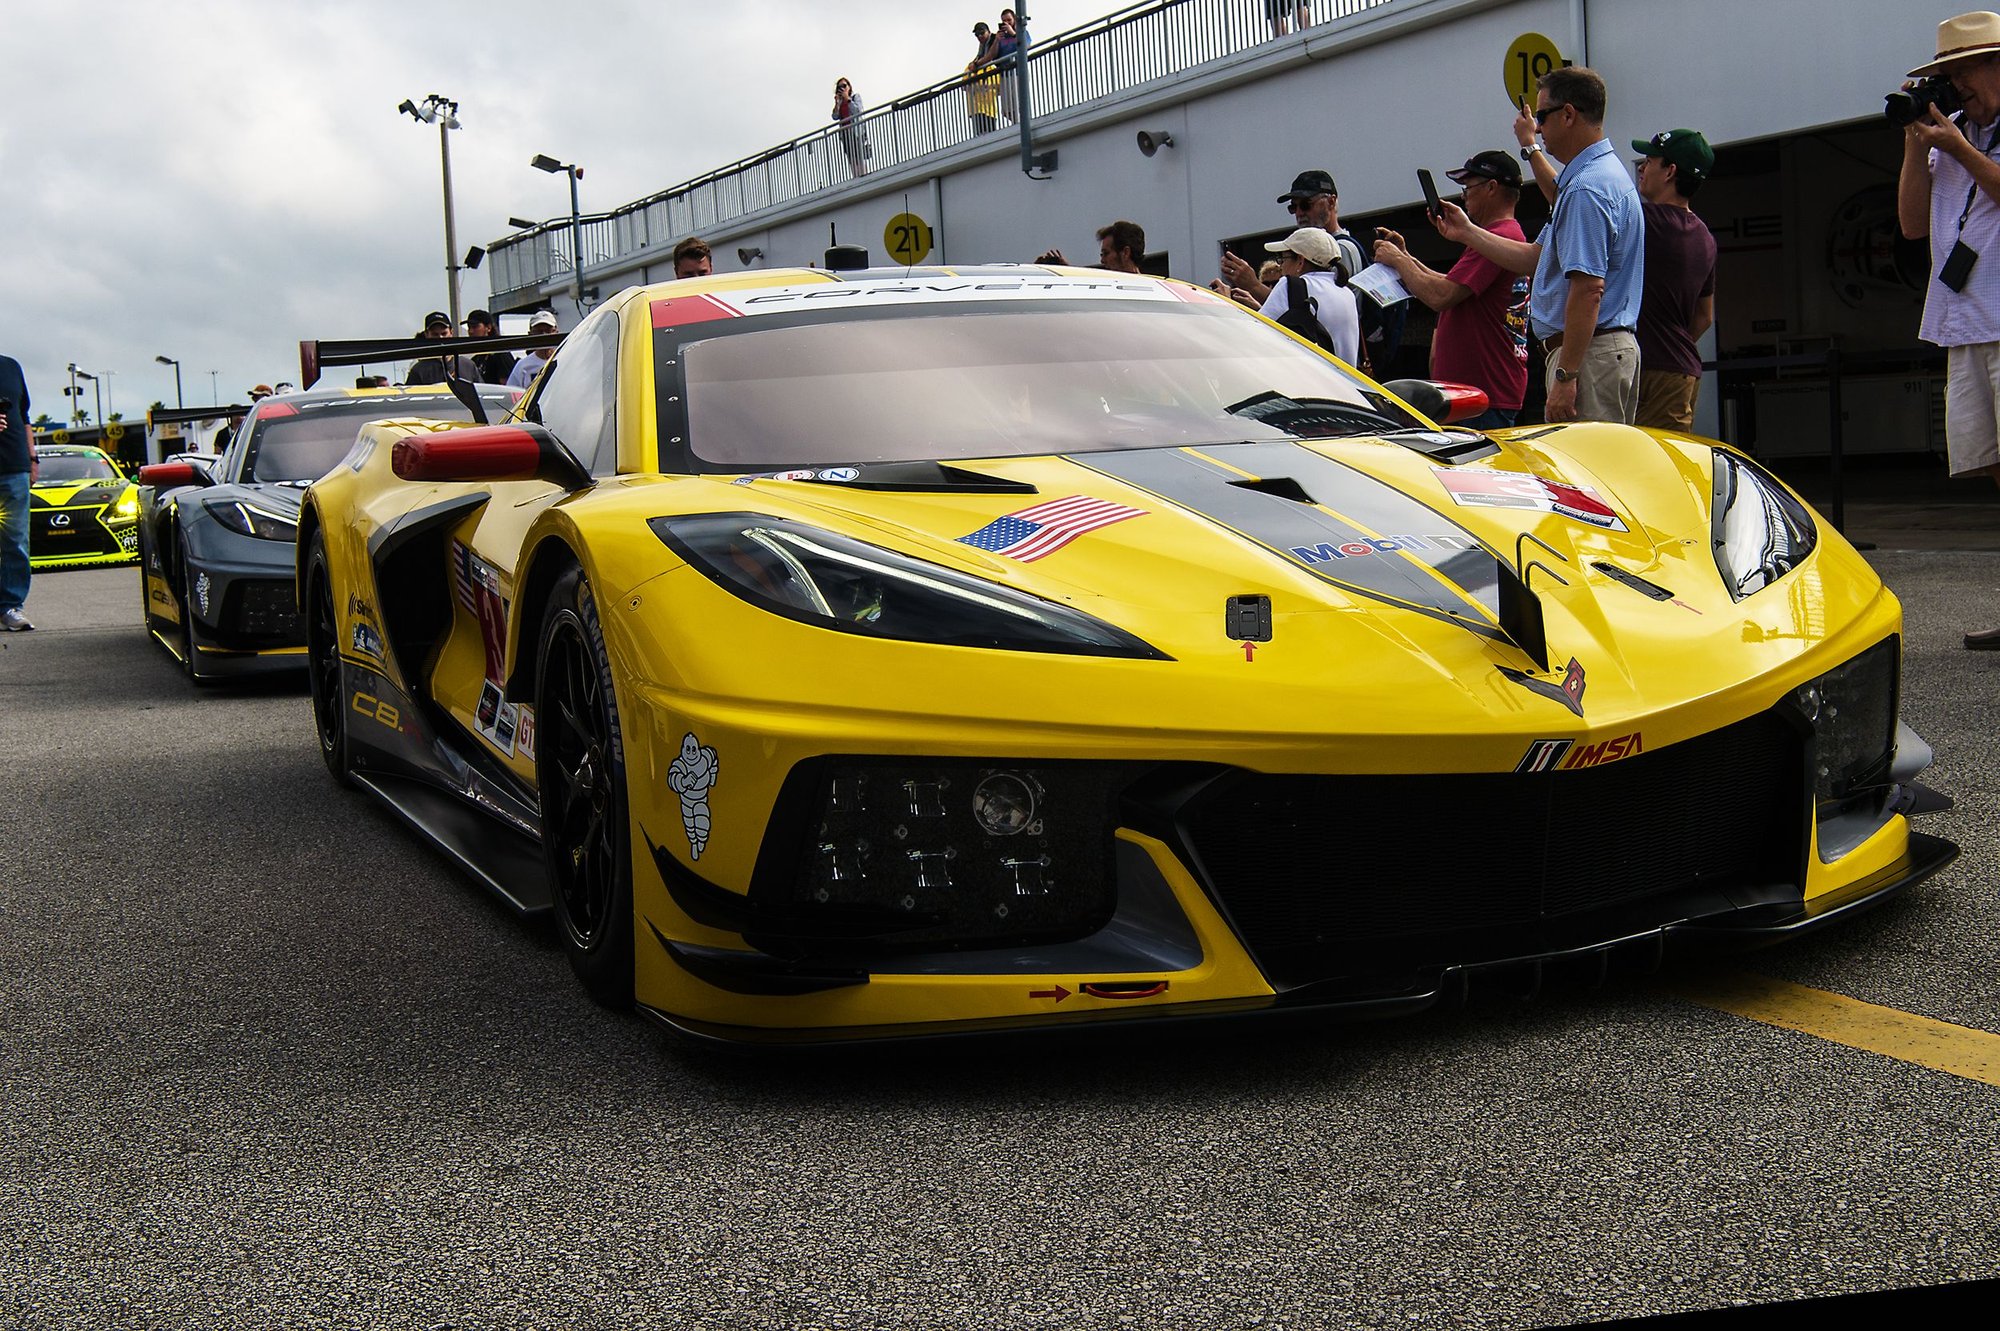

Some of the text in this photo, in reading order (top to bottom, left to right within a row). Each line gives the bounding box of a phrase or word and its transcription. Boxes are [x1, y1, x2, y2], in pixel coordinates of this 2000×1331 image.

[893, 226, 920, 252] 21
[745, 282, 1155, 304] CORVETTE
[1903, 382, 1922, 393] 911
[302, 394, 505, 409] CORVETE
[55, 432, 67, 443] 46
[109, 425, 122, 436] 45
[1290, 534, 1428, 564] Mobil
[588, 617, 623, 763] MICHELIN
[1563, 731, 1643, 770] IMSA
